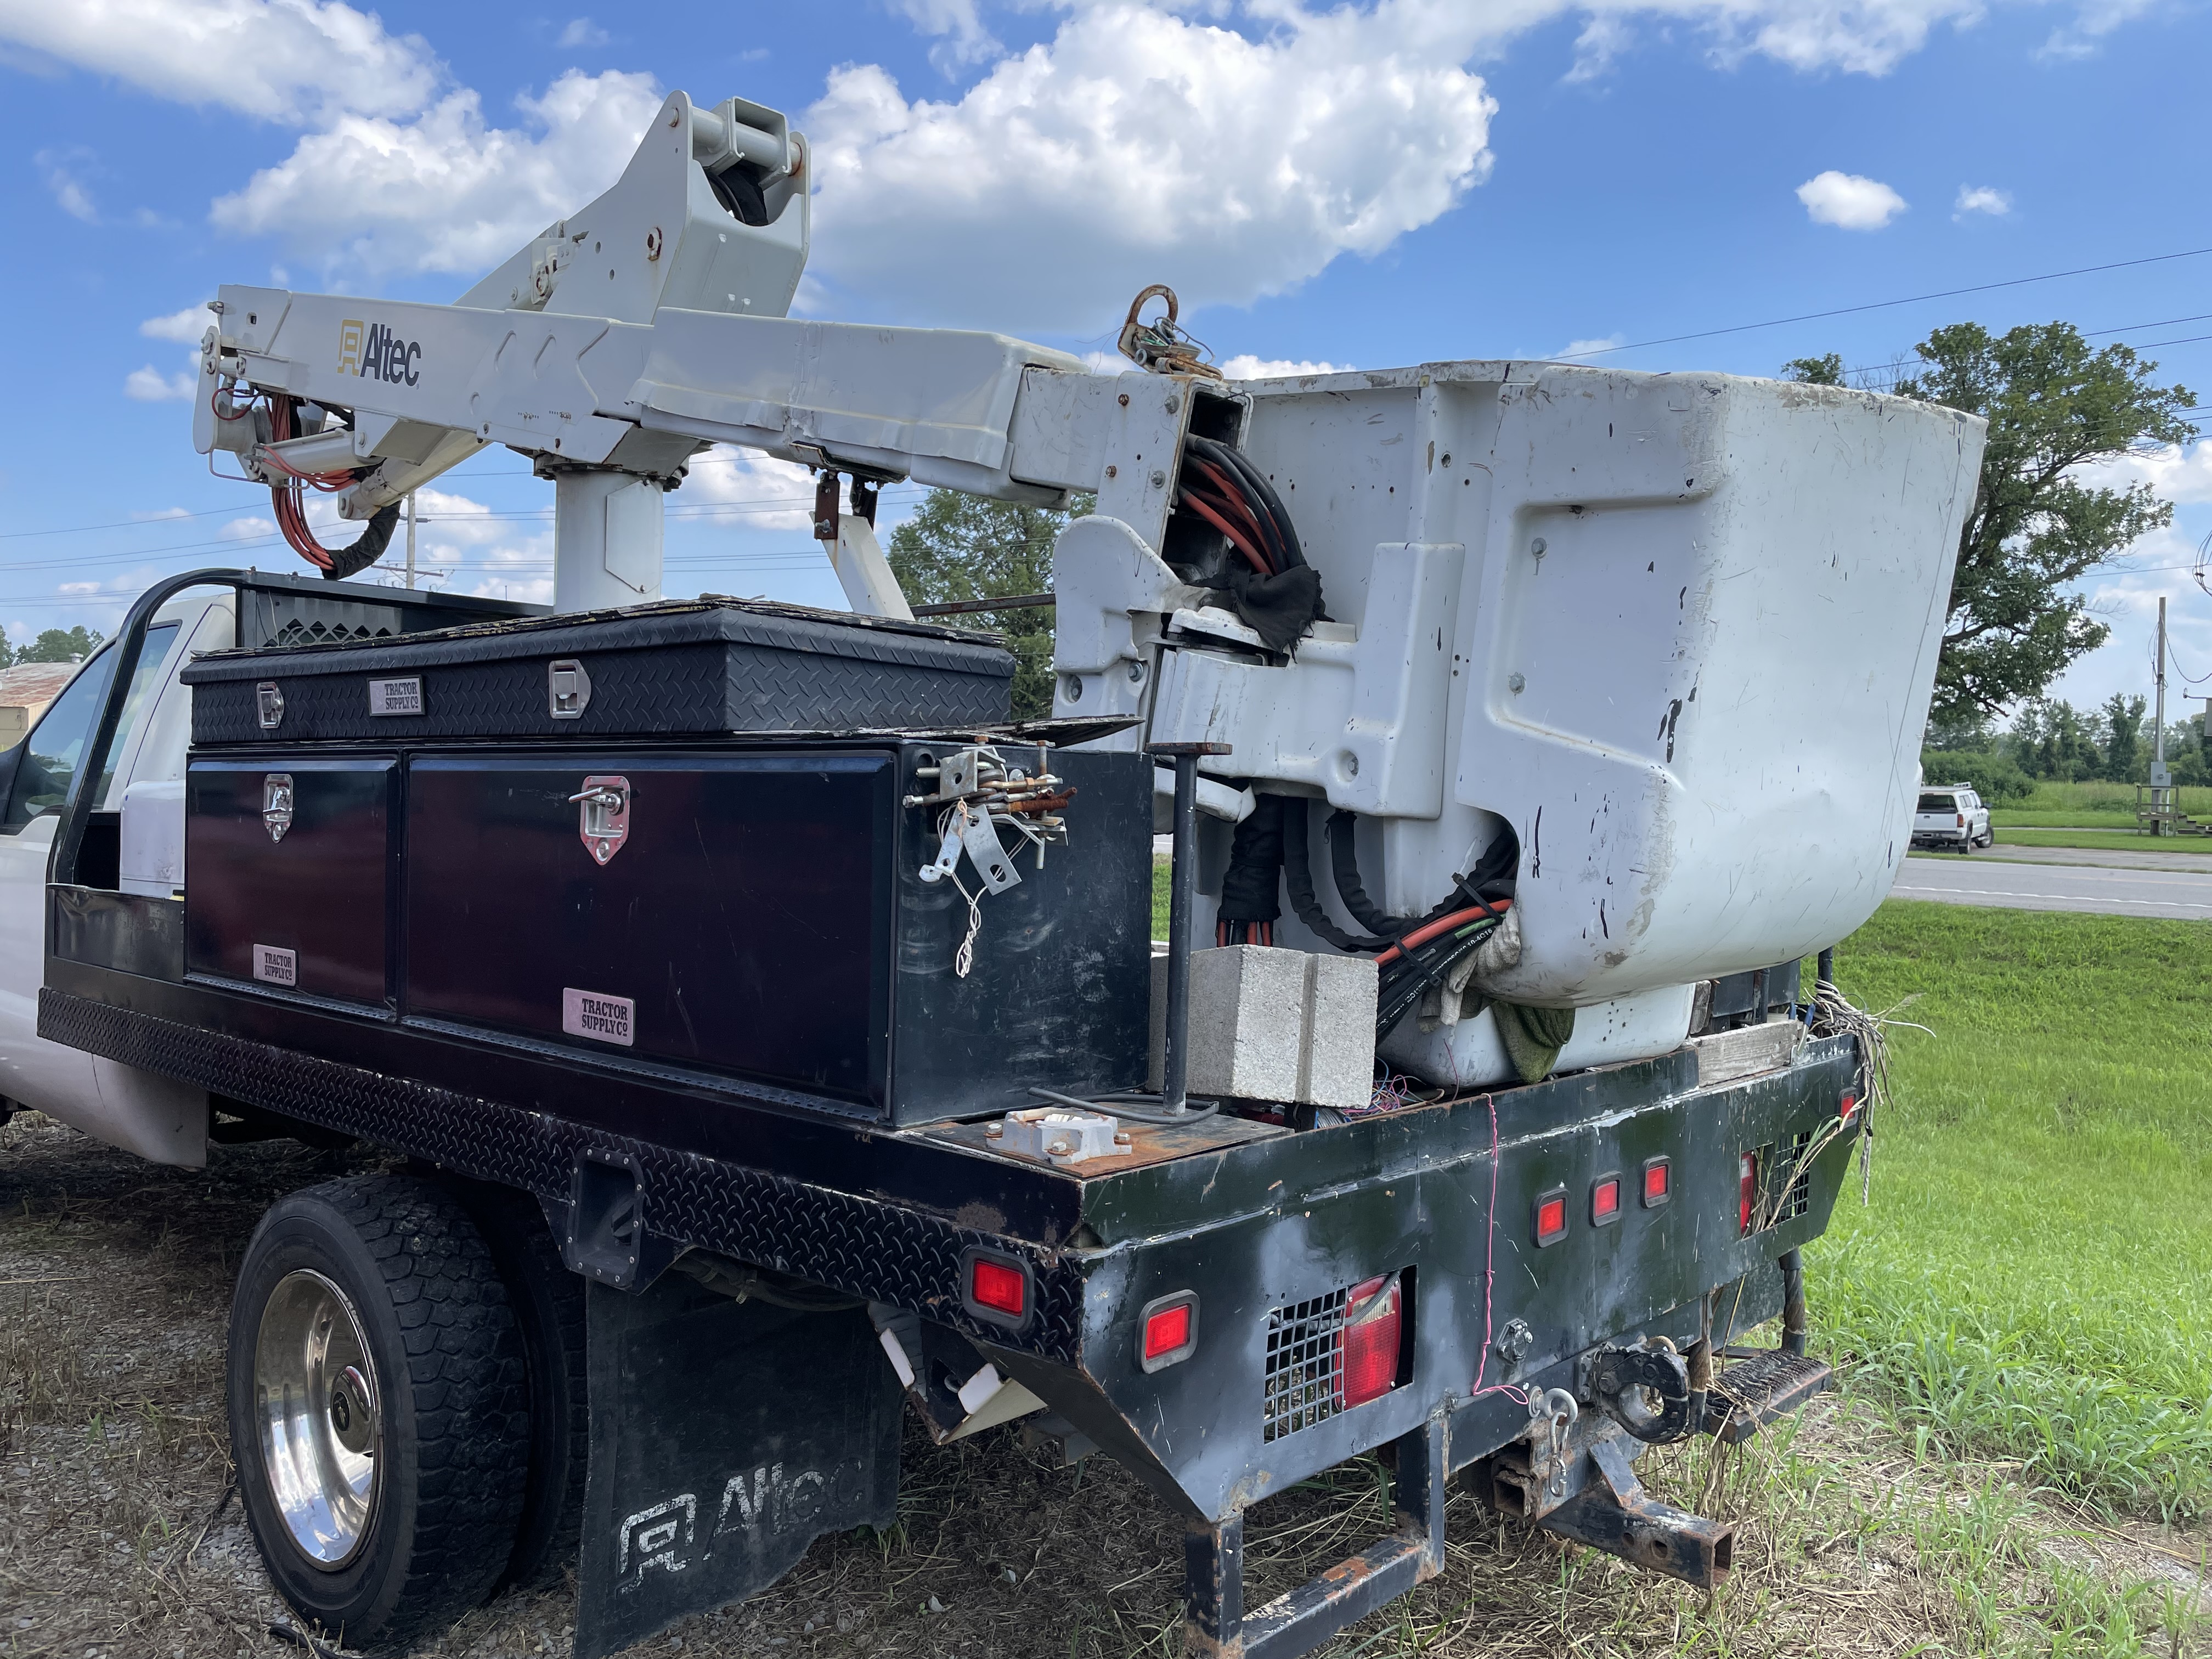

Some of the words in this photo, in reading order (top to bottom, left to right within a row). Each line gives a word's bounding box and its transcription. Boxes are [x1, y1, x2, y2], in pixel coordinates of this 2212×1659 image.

[360, 323, 421, 387] Altec
[385, 682, 417, 696] TRACTOR
[386, 697, 410, 709] SUPPLY
[264, 952, 292, 968] TRACTOR
[264, 964, 285, 979] SUPPLY
[582, 998, 628, 1021] TRACTOR
[582, 1014, 616, 1034] SUPPLY
